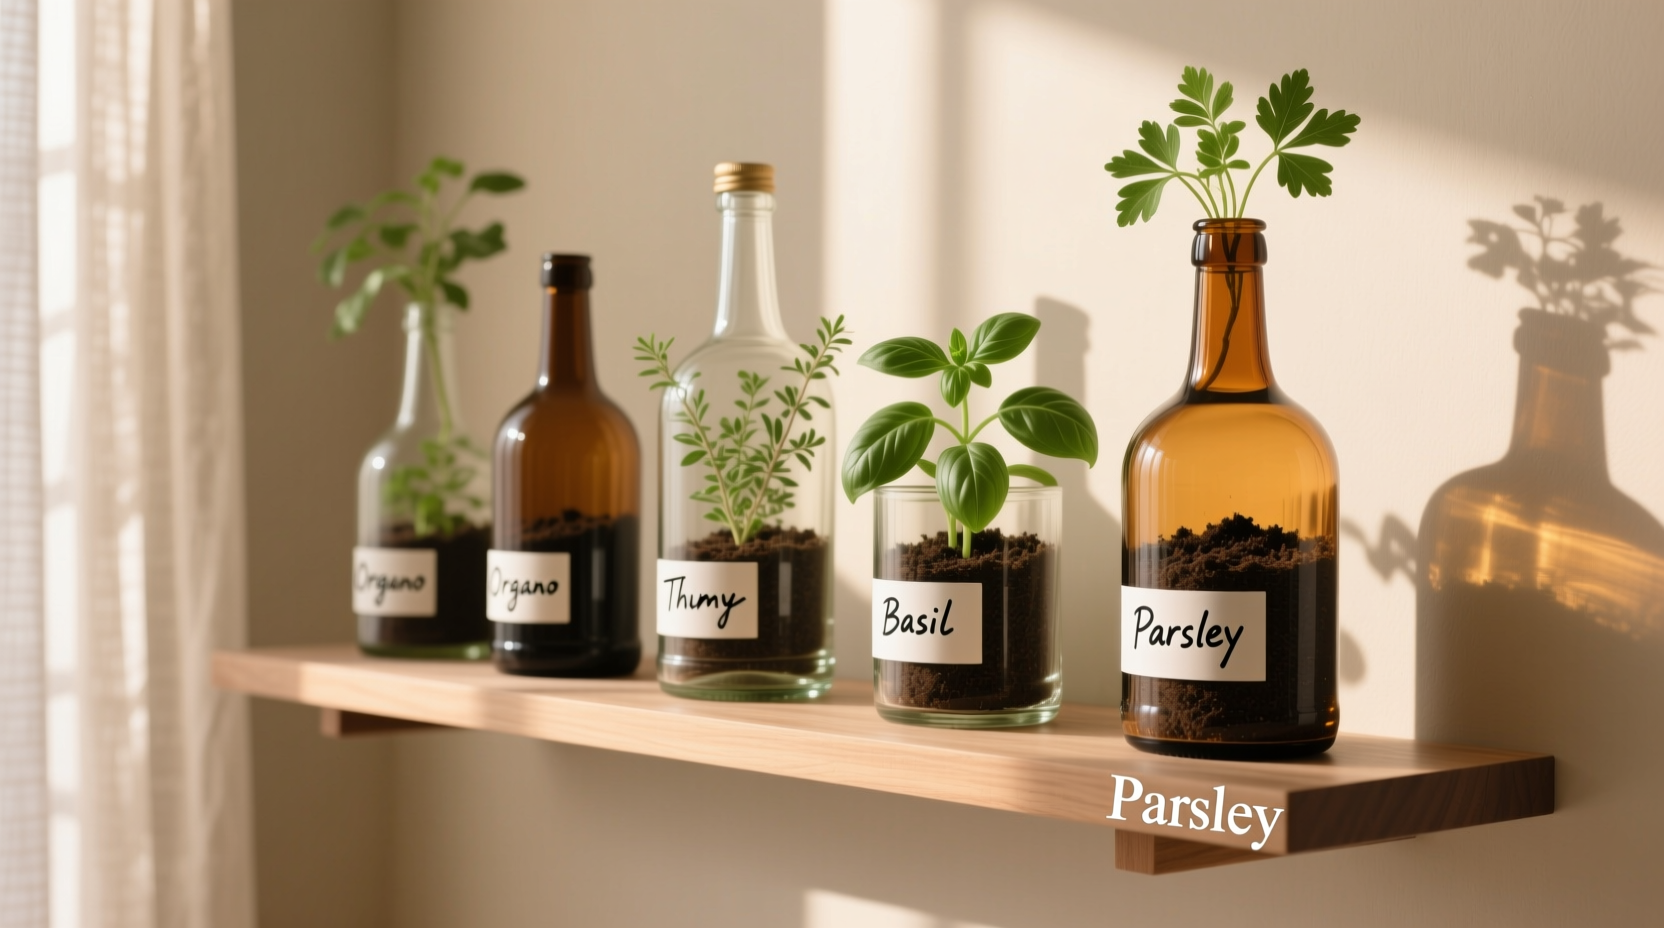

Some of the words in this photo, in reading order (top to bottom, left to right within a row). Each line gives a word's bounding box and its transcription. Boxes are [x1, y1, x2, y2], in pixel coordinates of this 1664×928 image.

[490, 566, 559, 612] Organo
[882, 596, 954, 636] Basil
[1134, 605, 1244, 669] Parsley
